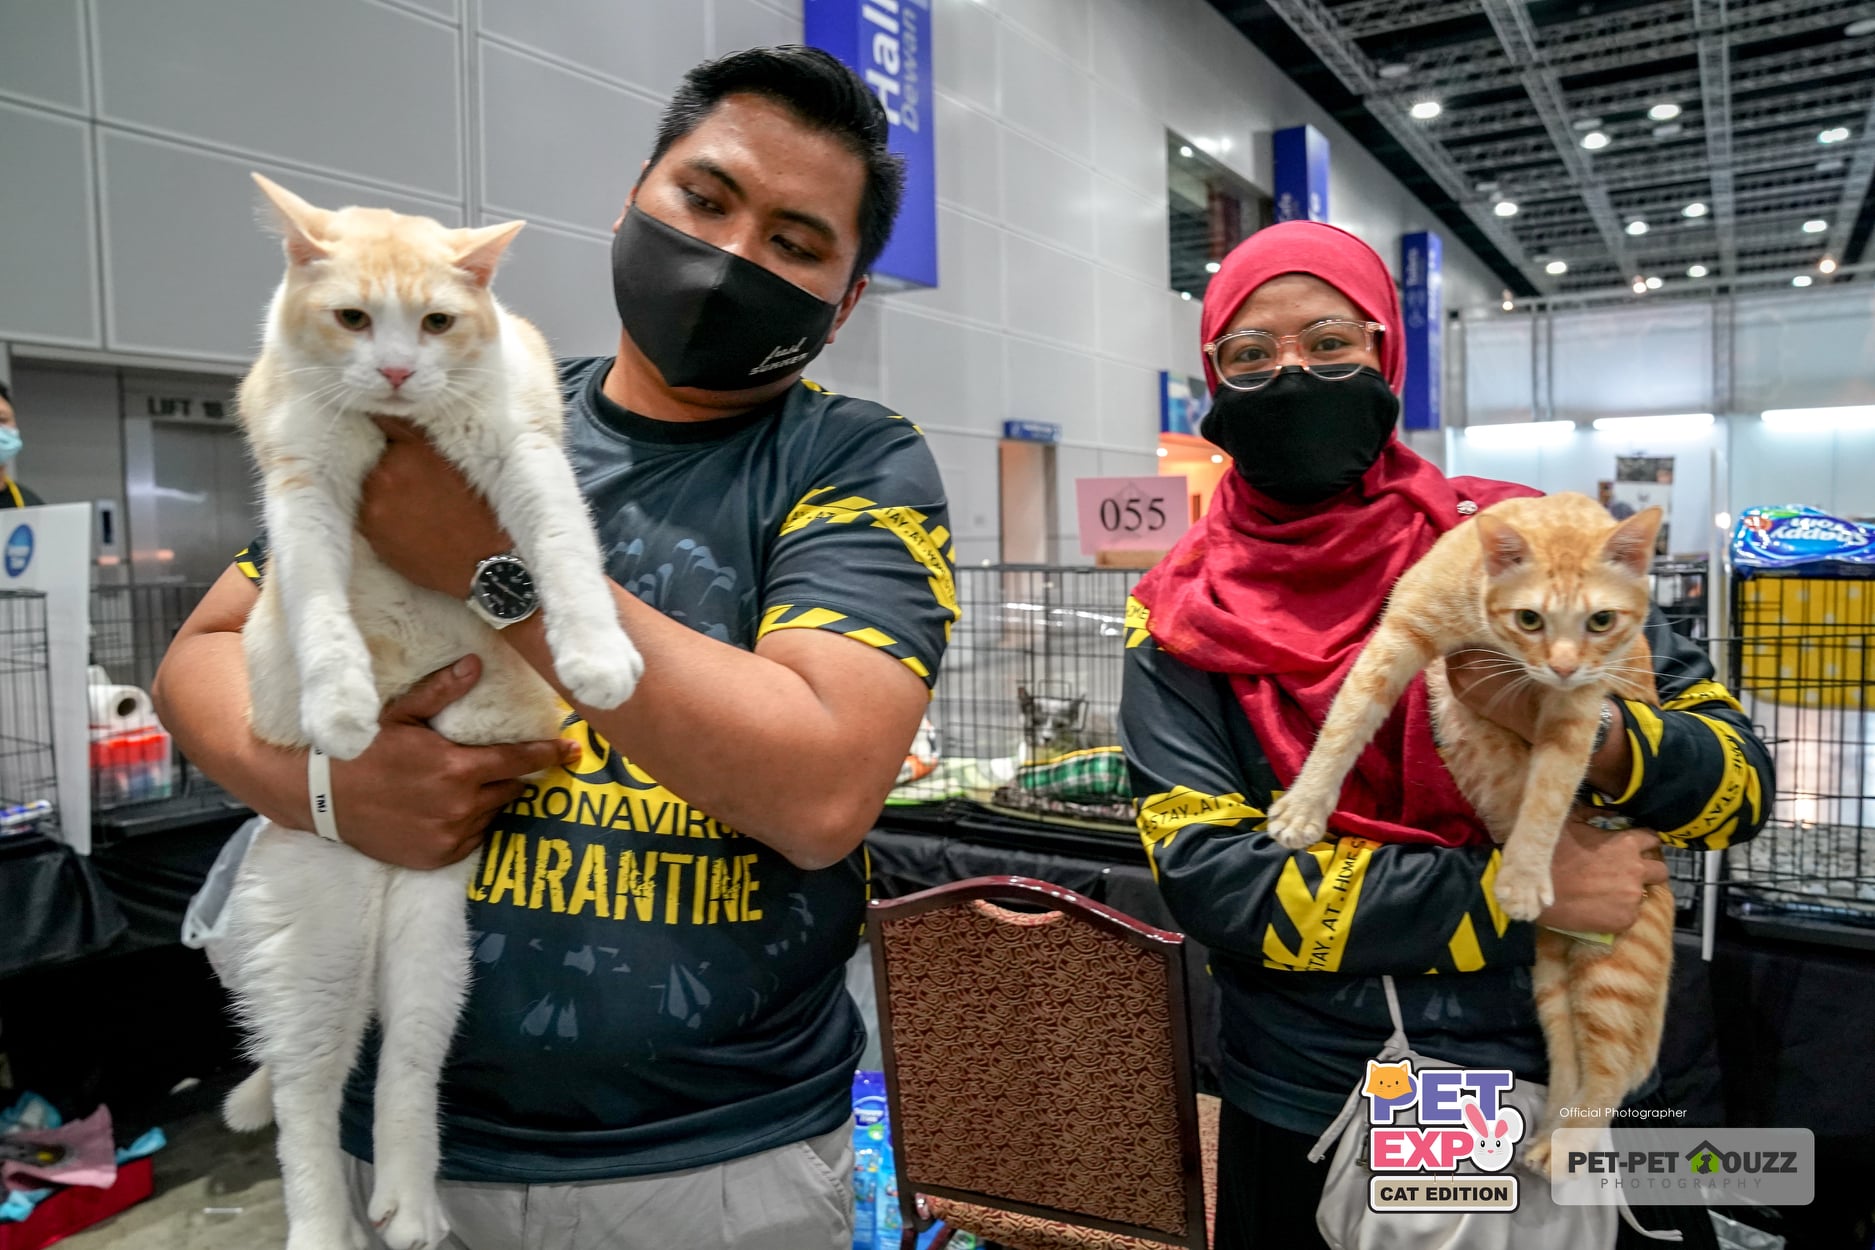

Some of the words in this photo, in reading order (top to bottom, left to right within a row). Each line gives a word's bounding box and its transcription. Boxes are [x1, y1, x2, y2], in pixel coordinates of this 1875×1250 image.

[901, 8, 919, 133] Dewan
[1100, 498, 1166, 532] 055
[467, 830, 763, 925] UARANTINE
